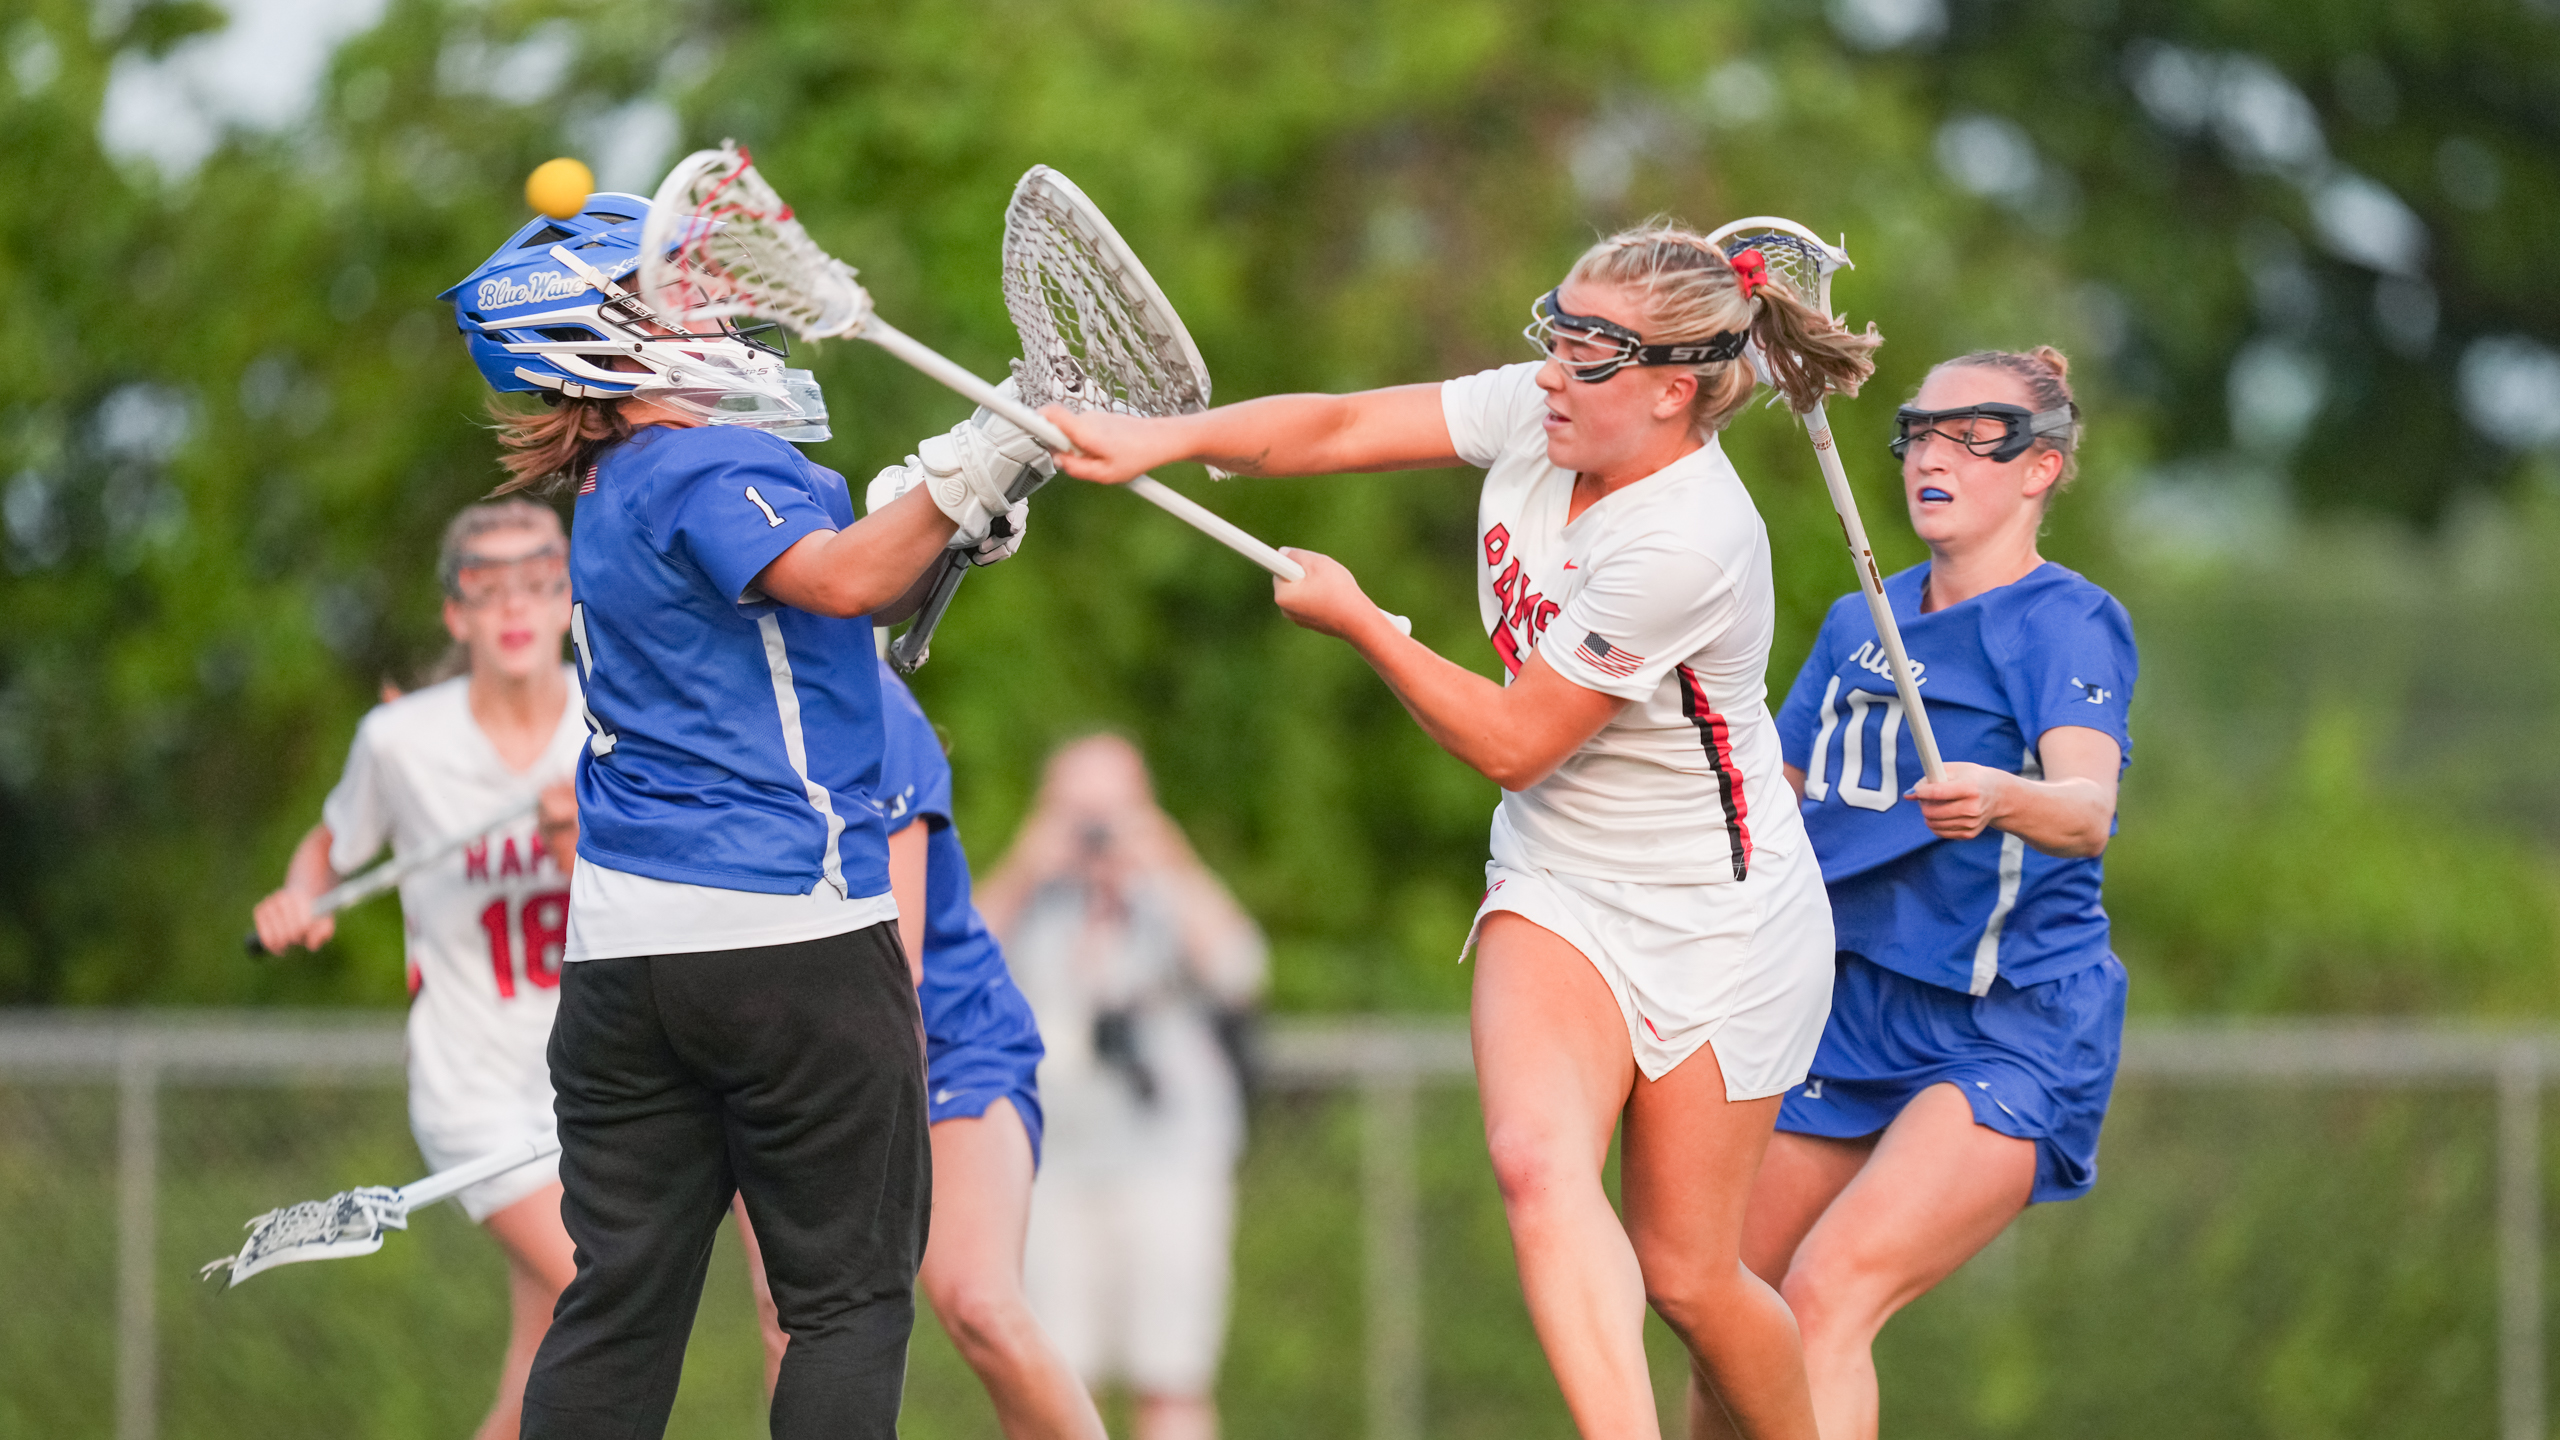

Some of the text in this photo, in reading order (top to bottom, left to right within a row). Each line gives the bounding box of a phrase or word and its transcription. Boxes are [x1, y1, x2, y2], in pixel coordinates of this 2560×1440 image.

[479, 272, 585, 308] Blue Wave
[744, 485, 787, 529] 1
[1804, 674, 1905, 812] 10
[480, 891, 570, 998] 18
